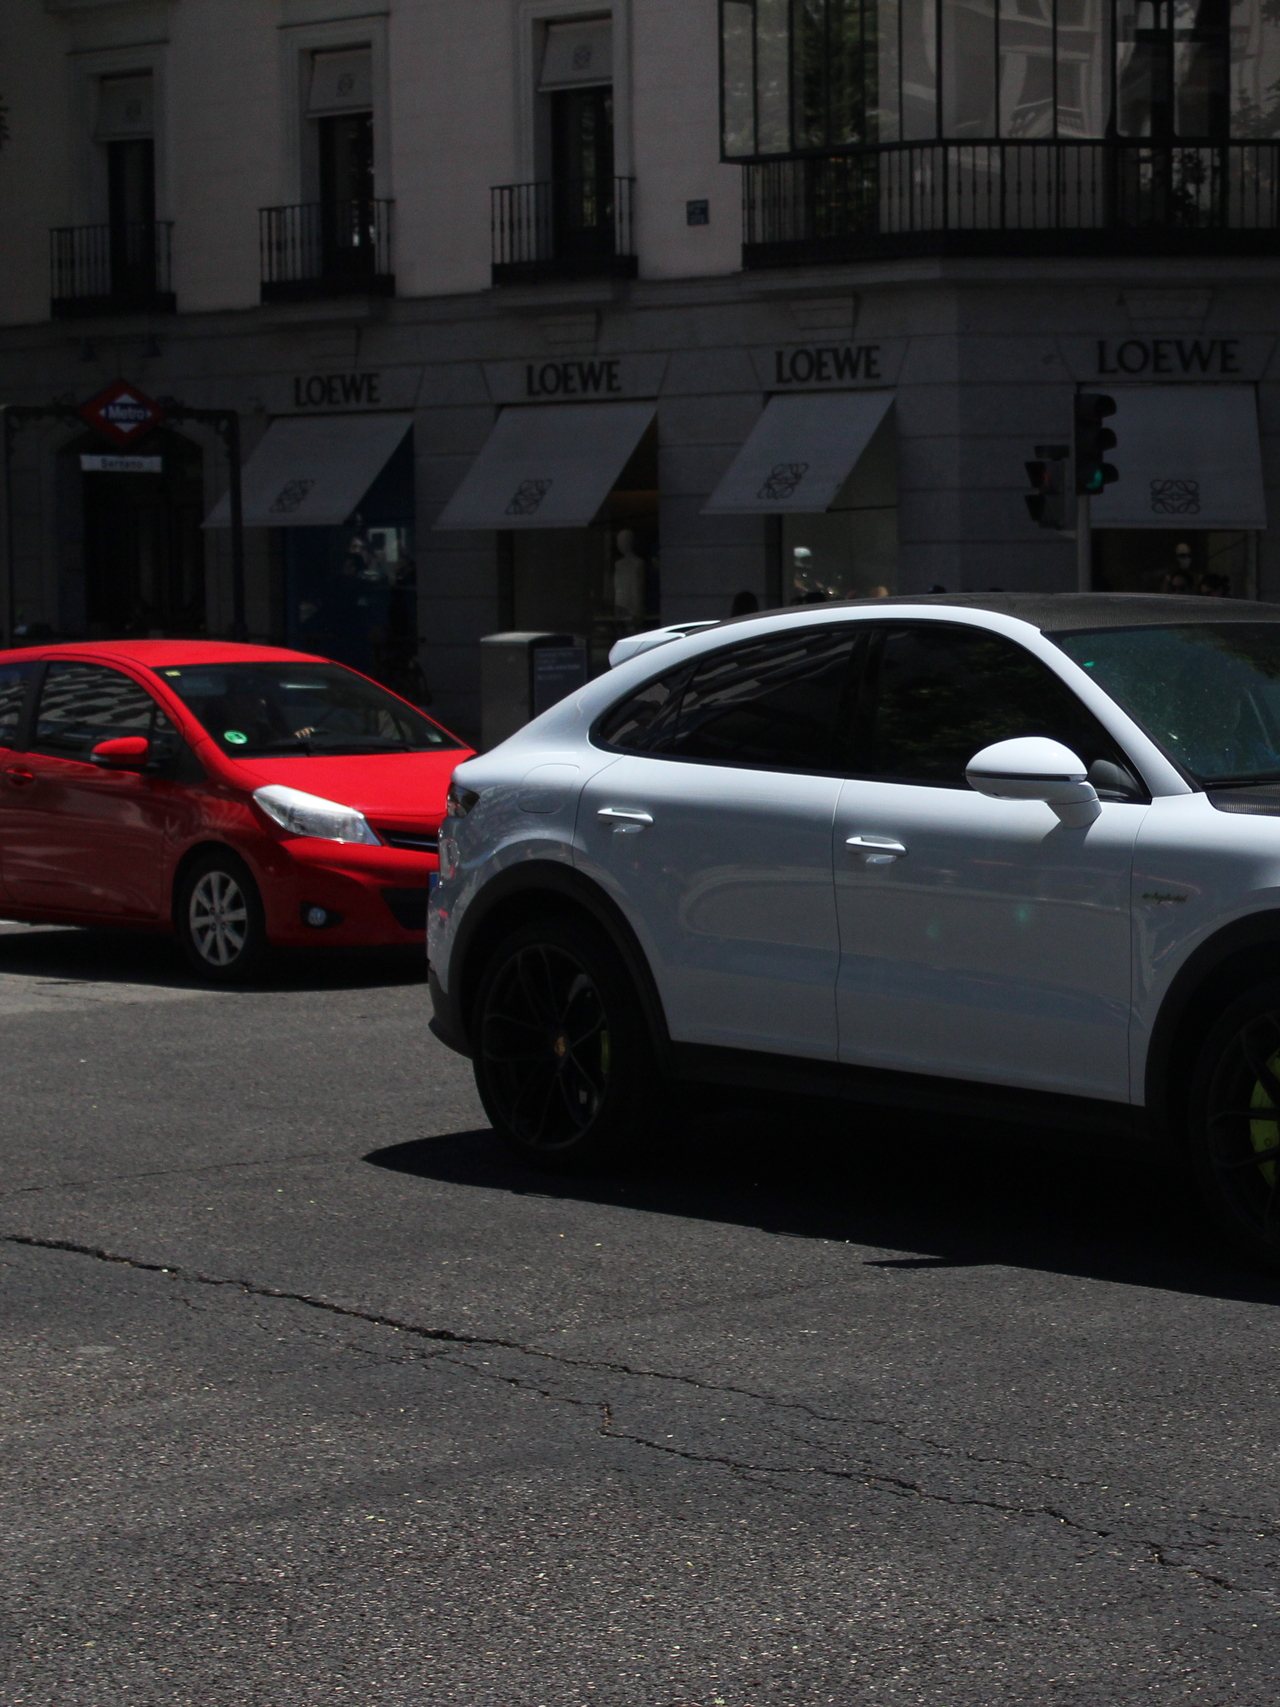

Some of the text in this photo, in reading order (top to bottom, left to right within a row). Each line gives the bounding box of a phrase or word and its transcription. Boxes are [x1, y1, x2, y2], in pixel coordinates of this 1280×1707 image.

[776, 345, 881, 384] LOEWE
[1097, 339, 1241, 375] LOEWE
[294, 373, 380, 407] LOEWE
[527, 361, 621, 396] LOEWE
[108, 405, 145, 421] Metro
